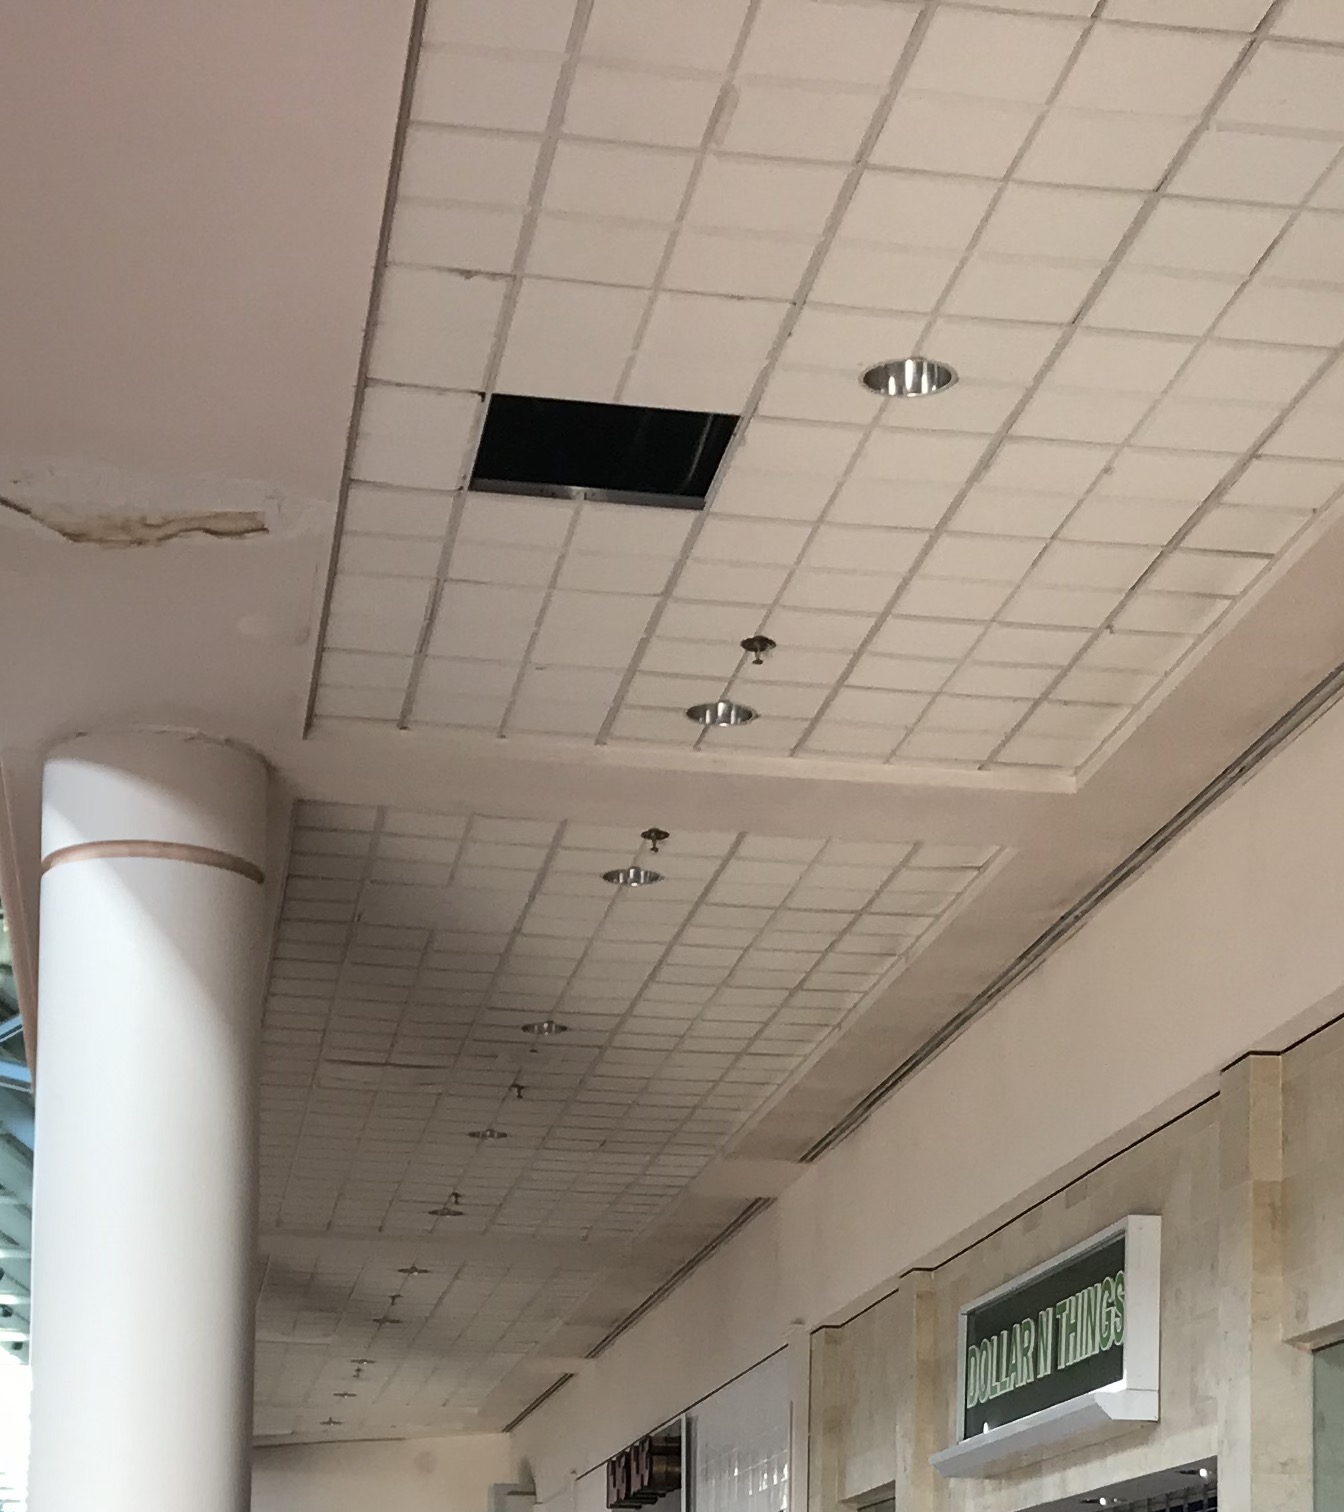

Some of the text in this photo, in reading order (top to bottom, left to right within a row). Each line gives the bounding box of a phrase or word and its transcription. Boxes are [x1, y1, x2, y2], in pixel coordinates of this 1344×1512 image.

[967, 1270, 1125, 1409] DOLLAR N THINGS
